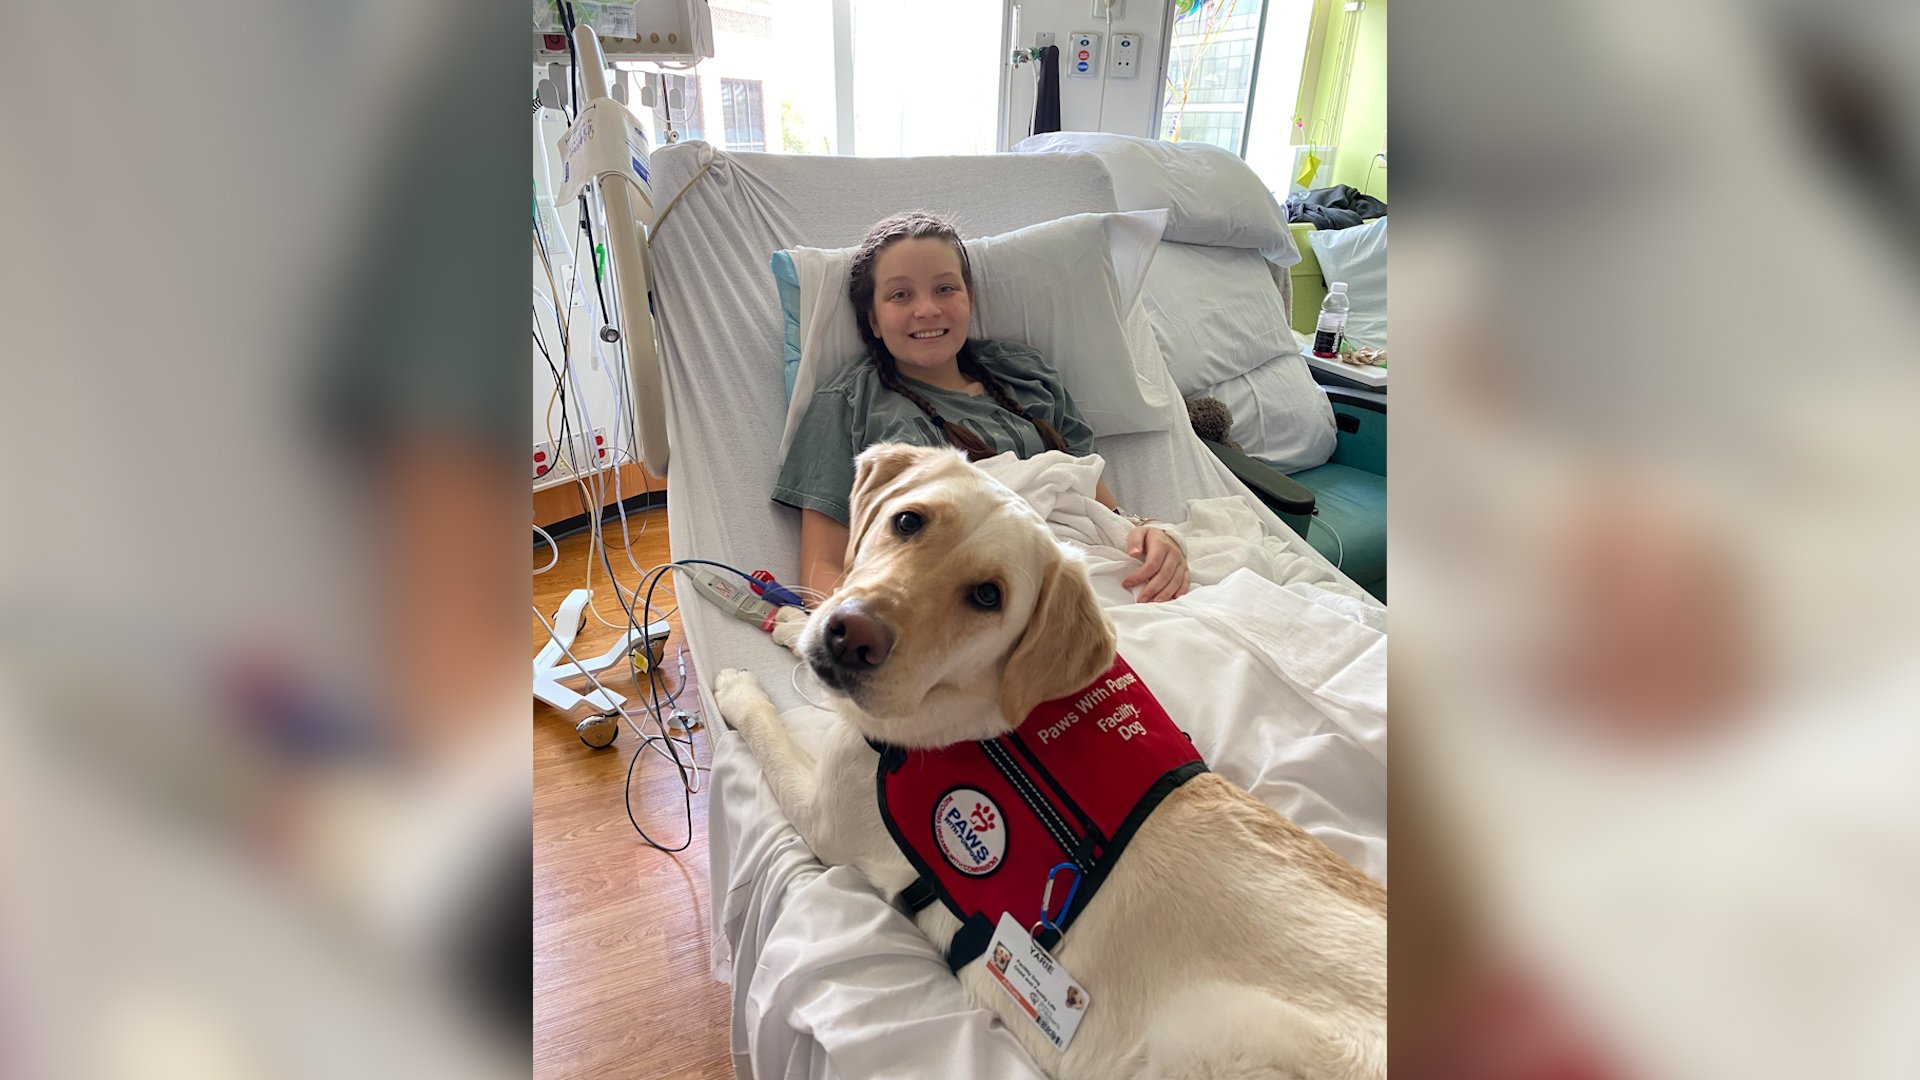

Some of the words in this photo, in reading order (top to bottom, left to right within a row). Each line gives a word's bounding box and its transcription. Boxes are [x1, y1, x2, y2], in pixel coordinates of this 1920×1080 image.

[1036, 710, 1080, 745] Paws
[1074, 687, 1111, 714] With
[1096, 702, 1139, 733] Facility
[1117, 720, 1147, 742] Dog
[943, 815, 960, 834] WITH
[957, 832, 981, 865] PURPOSE
[946, 807, 989, 861] PAWS
[1029, 946, 1056, 975] YARIE
